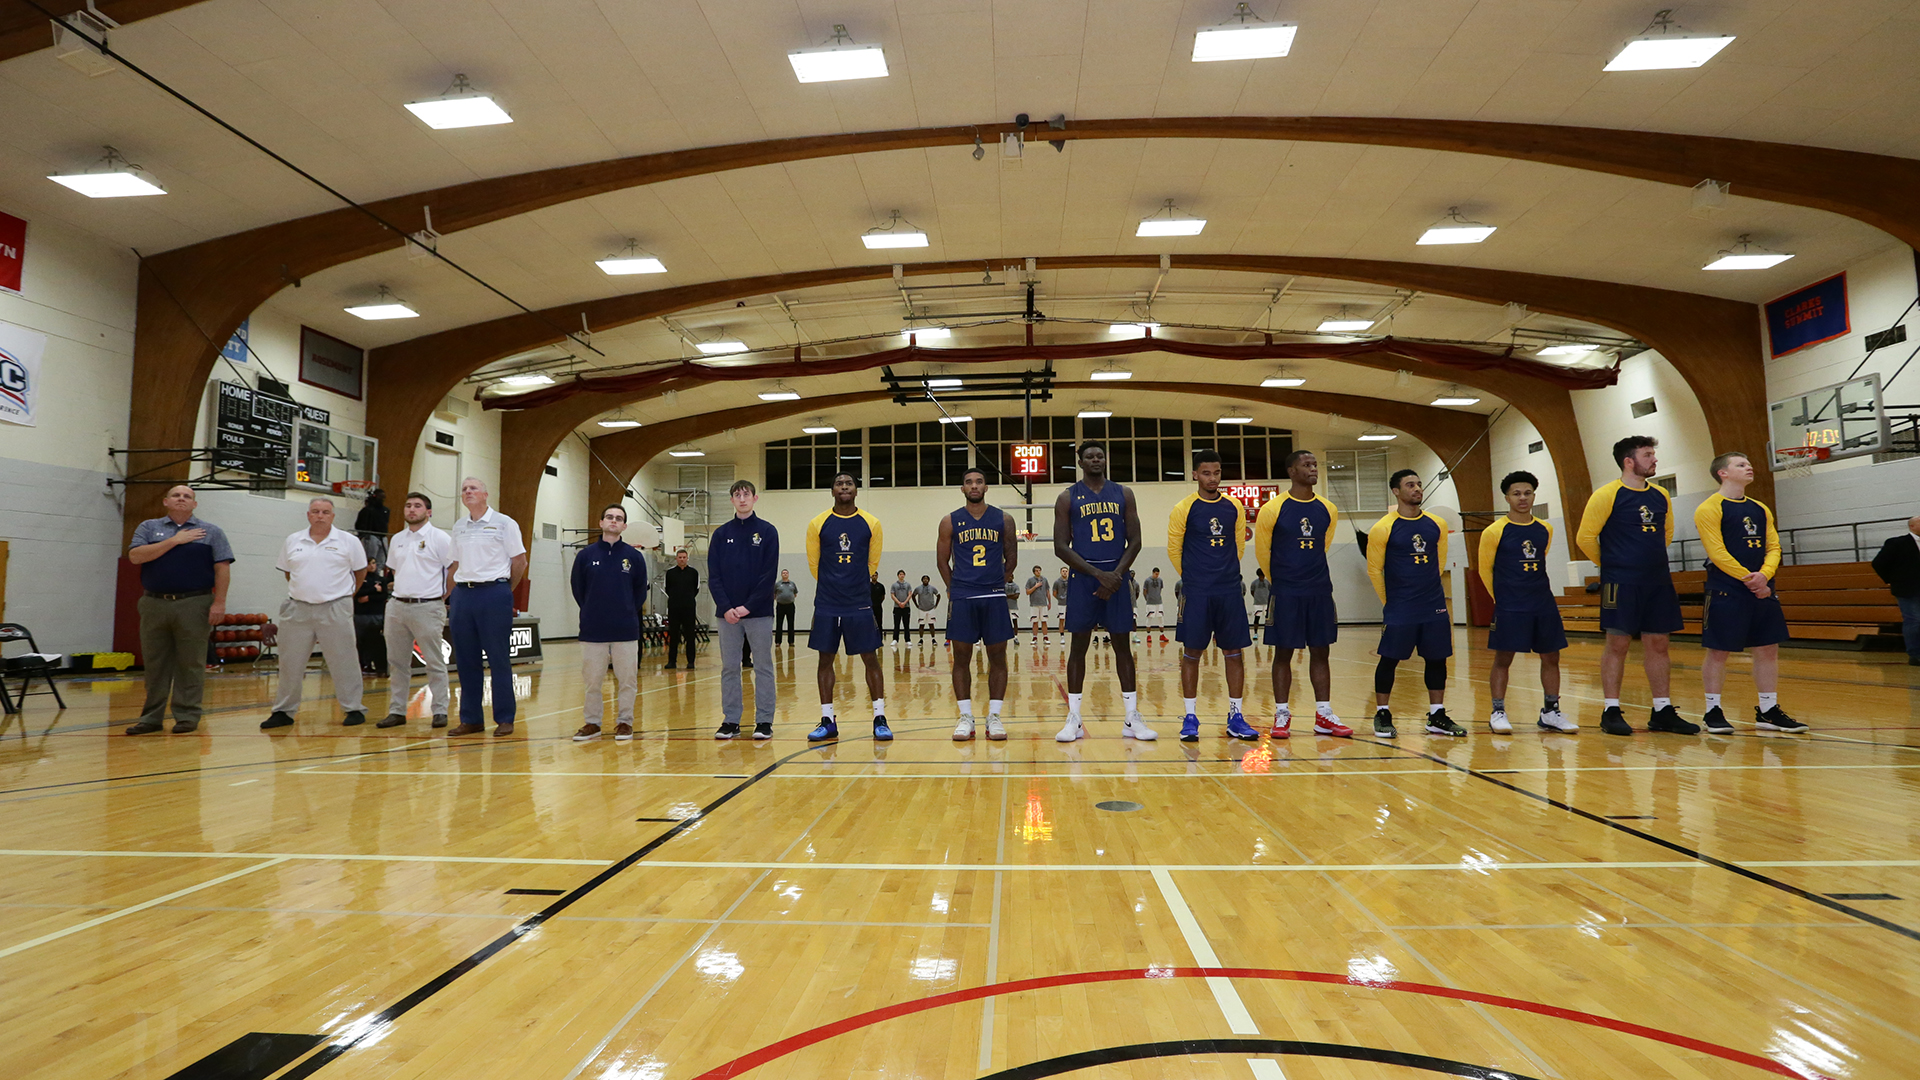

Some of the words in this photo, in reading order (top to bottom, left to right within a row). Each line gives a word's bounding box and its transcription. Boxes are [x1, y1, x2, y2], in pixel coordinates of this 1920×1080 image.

[1784, 306, 1824, 329] SUMMIT
[221, 384, 250, 401] HOME
[304, 407, 328, 422] GUEST
[222, 433, 245, 444] FOULS
[1014, 446, 1043, 457] 20:00
[1020, 458, 1038, 473] 30
[1230, 487, 1259, 498] 20:00
[1080, 502, 1120, 518] NEUMANN
[958, 529, 999, 544] NEUMANN
[1090, 518, 1115, 542] 13
[972, 544, 987, 567] 2
